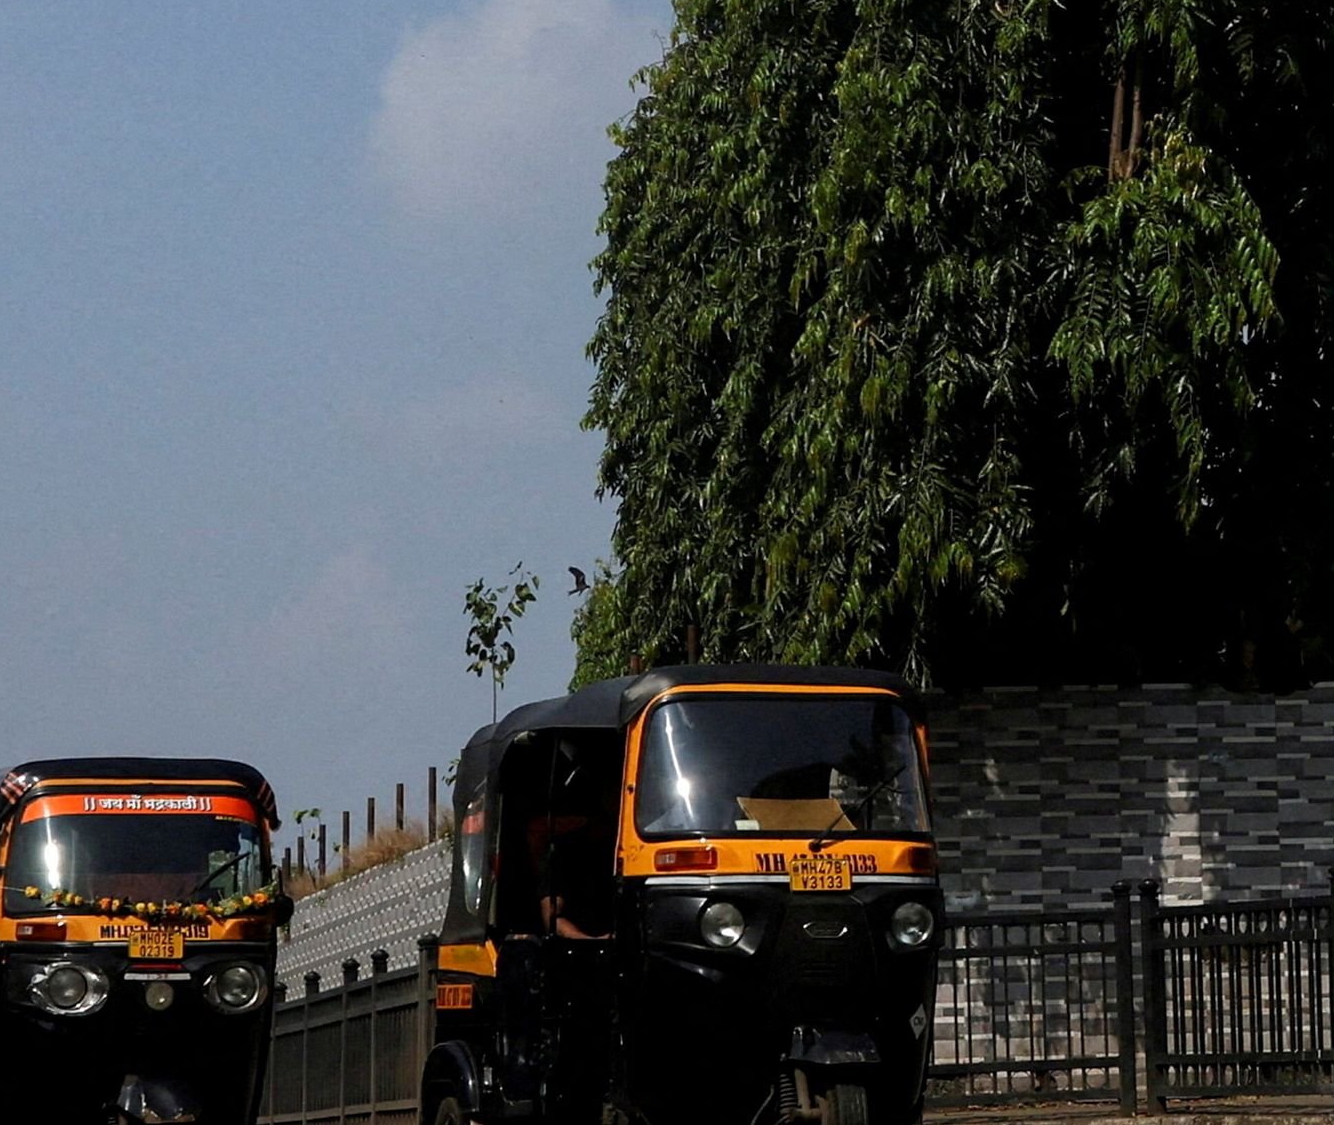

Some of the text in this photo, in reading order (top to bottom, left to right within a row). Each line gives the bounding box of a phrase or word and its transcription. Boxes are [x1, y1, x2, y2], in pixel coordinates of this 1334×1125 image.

[99, 797, 123, 809] जय
[755, 853, 786, 872] MH
[801, 861, 842, 875] MH47B
[801, 875, 843, 889] V3133
[140, 933, 174, 945] MH02E
